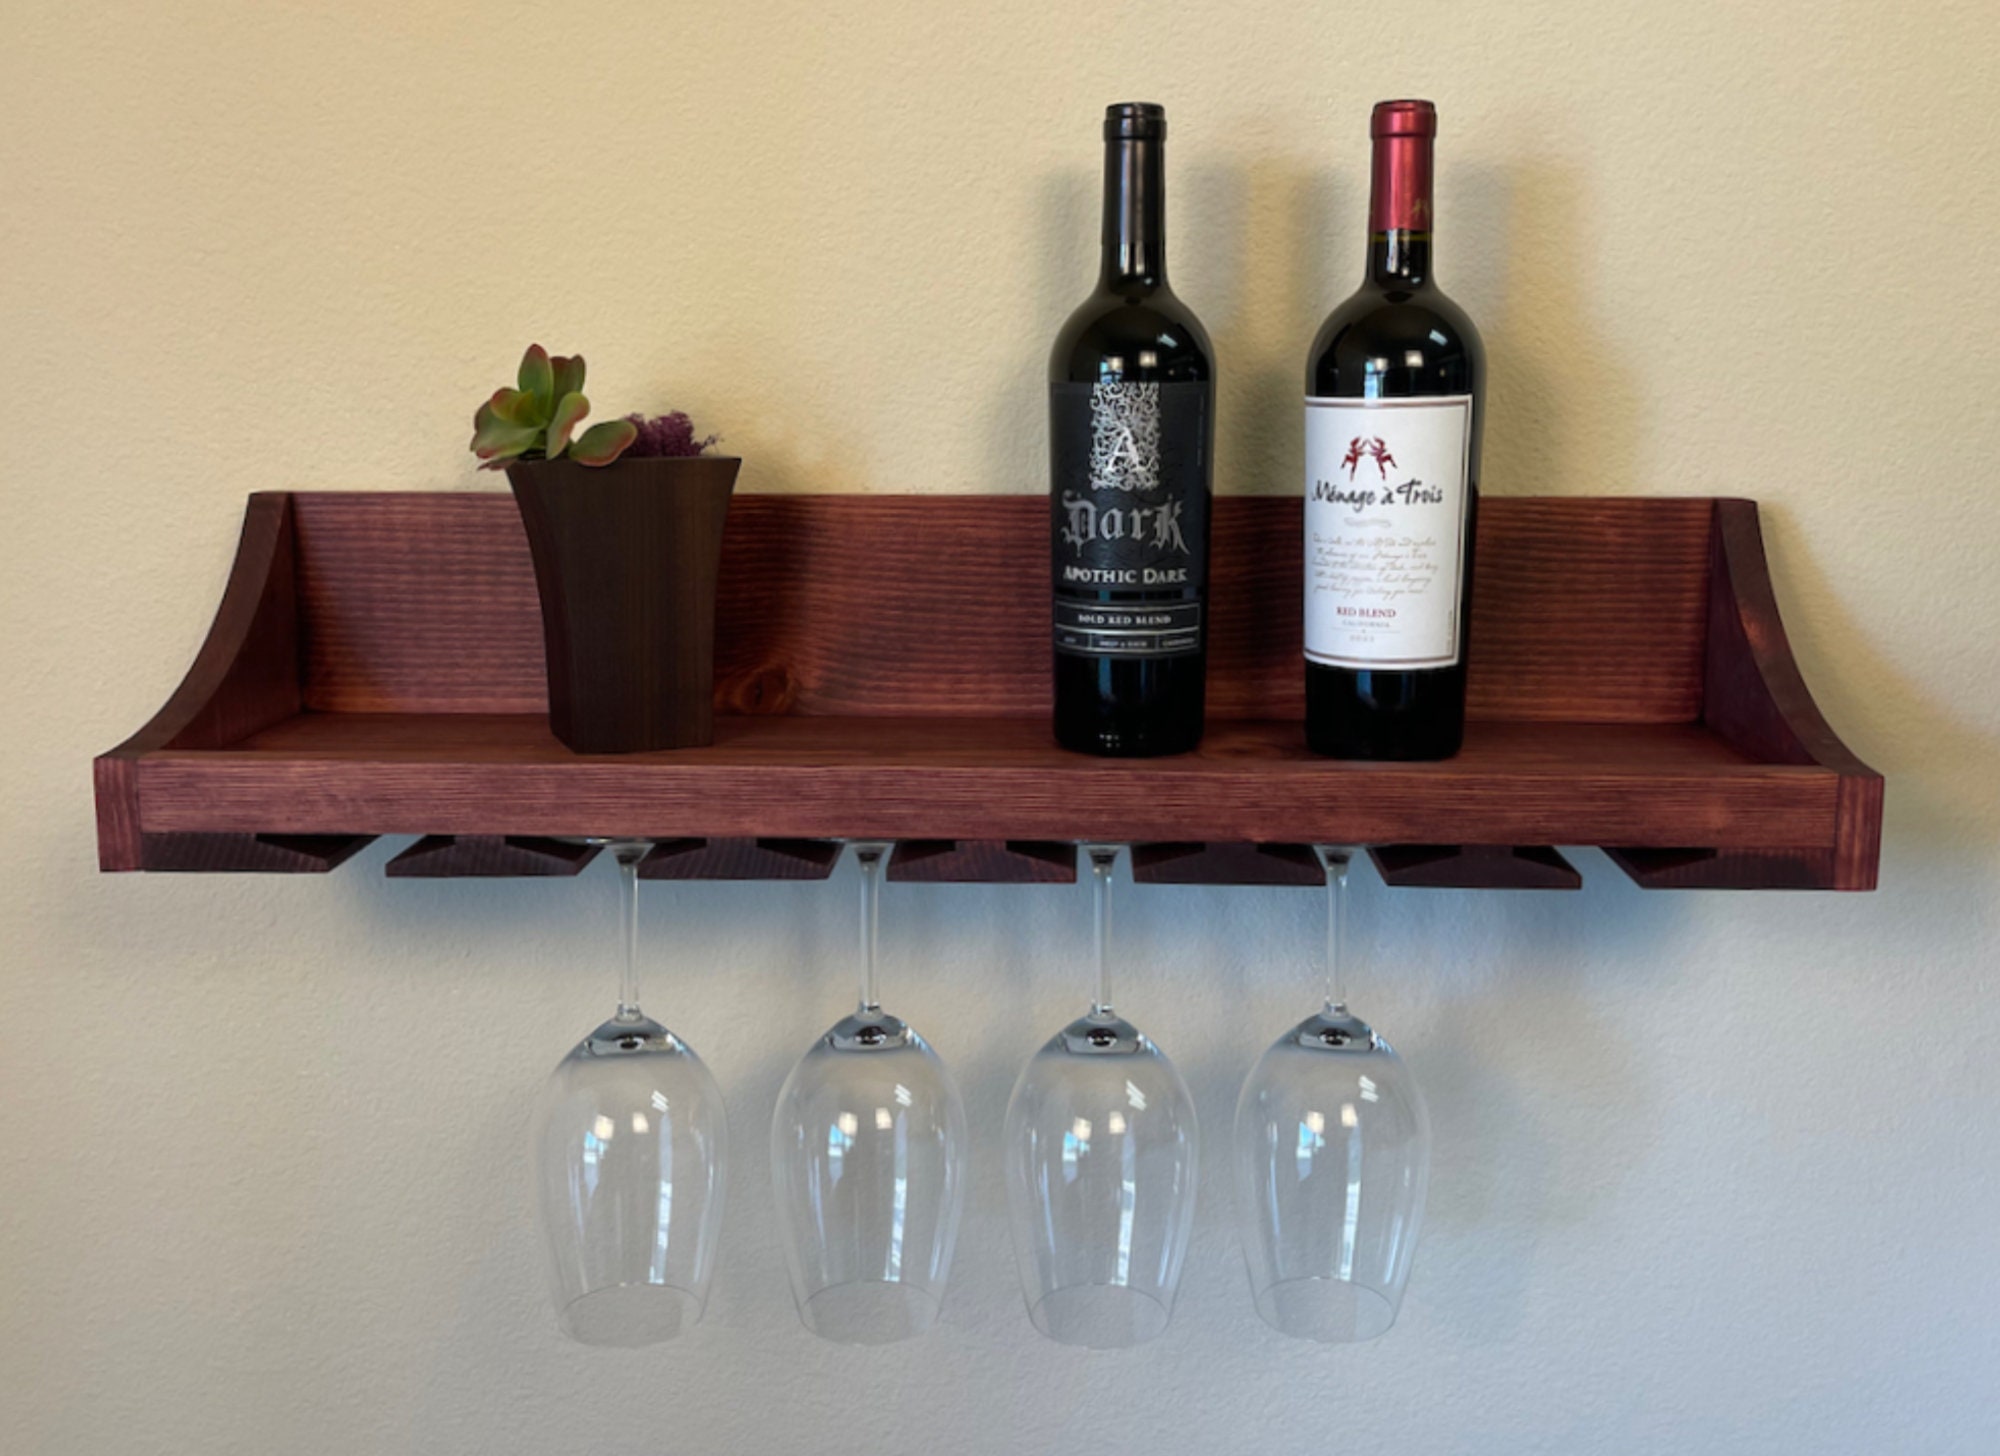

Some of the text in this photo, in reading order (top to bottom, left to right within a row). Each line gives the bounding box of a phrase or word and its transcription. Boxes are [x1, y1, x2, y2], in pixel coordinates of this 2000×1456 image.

[1311, 478, 1443, 513] Ménage à Trois
[1336, 606, 1397, 618] RED BLEND
[1077, 614, 1172, 625] BOLD RED BLEND
